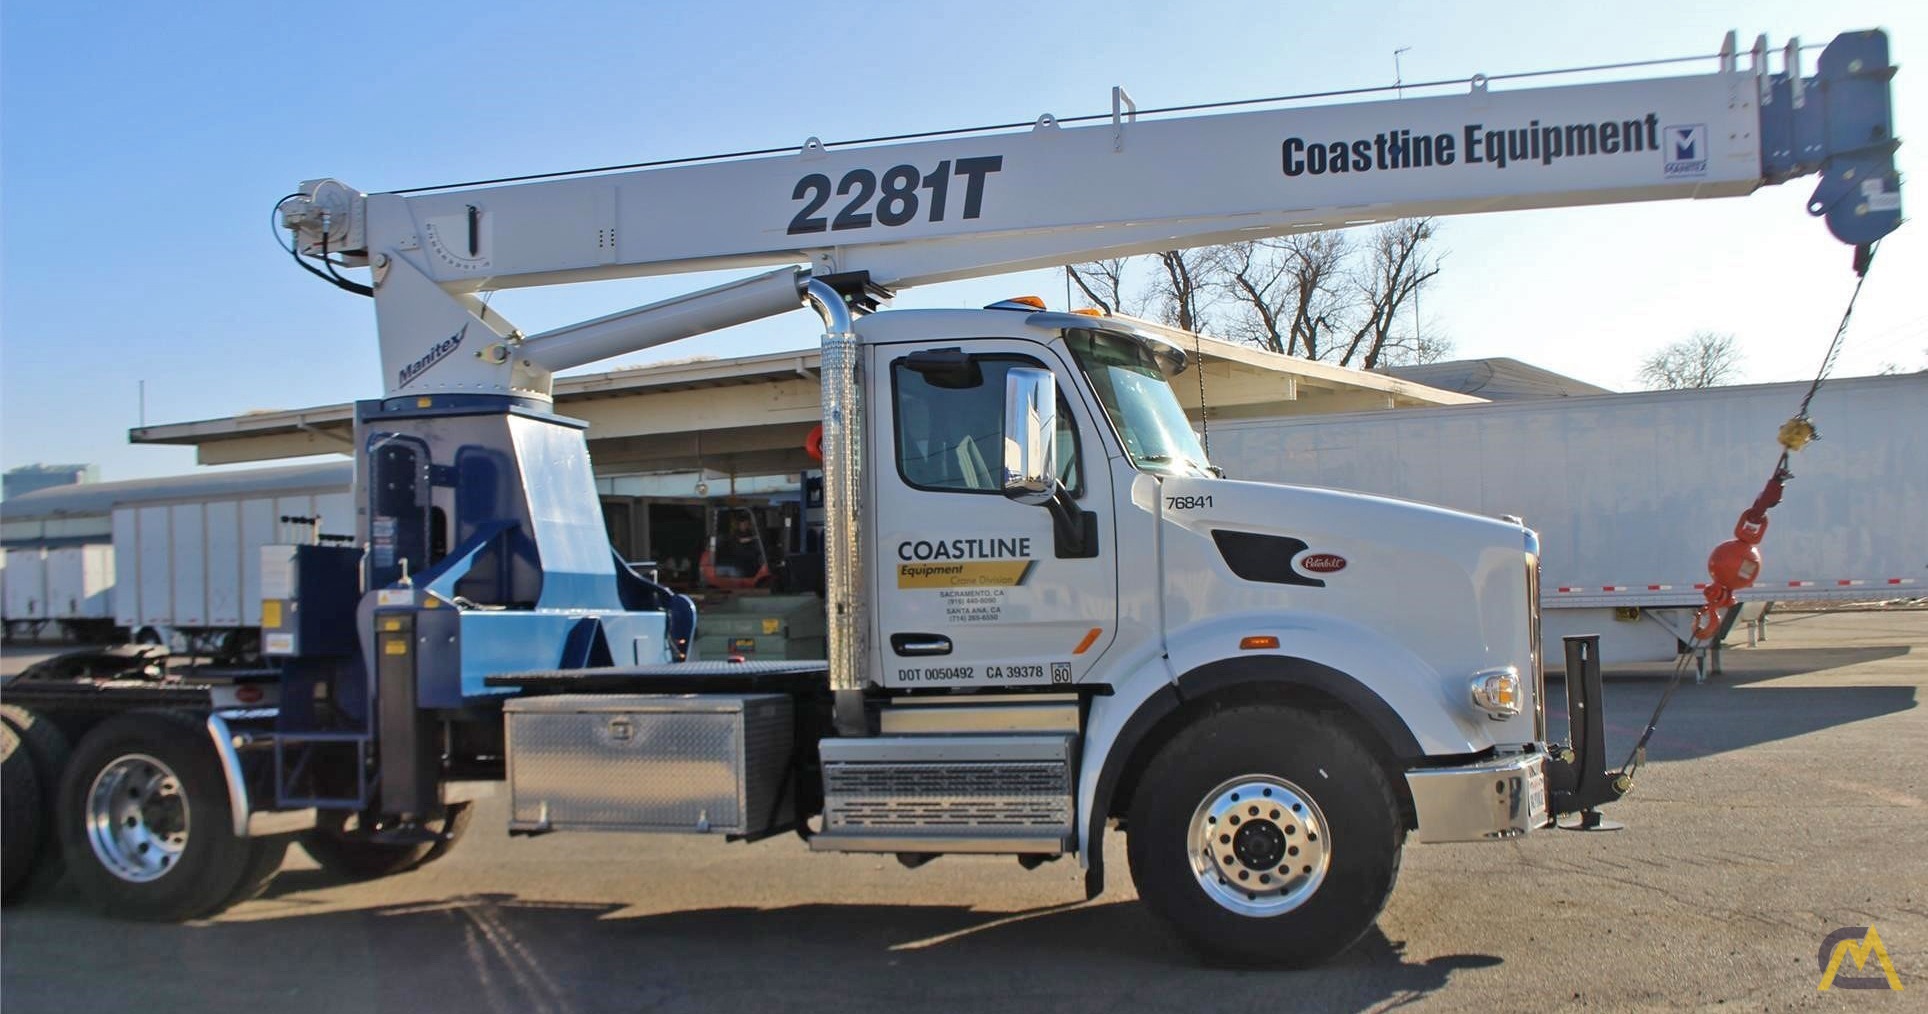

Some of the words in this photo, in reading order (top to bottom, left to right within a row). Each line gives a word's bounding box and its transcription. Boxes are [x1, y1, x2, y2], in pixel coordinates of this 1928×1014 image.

[1282, 129, 1455, 177] Coastline
[1464, 112, 1660, 168] Equipment
[786, 155, 1003, 235] 2281T
[399, 332, 461, 386] Manitex
[1166, 495, 1213, 510] 76841
[898, 538, 1031, 560] COASTLINE
[1305, 556, 1344, 569] Peterbilt
[900, 563, 963, 578] Equipment
[950, 575, 976, 586] Crane
[979, 574, 1013, 585] Division
[946, 607, 971, 615] SANTA
[899, 669, 921, 681] DOT
[925, 667, 974, 681] 0050492
[986, 666, 1003, 679] CA
[1006, 665, 1044, 678] 39378
[1054, 668, 1069, 682] 80
